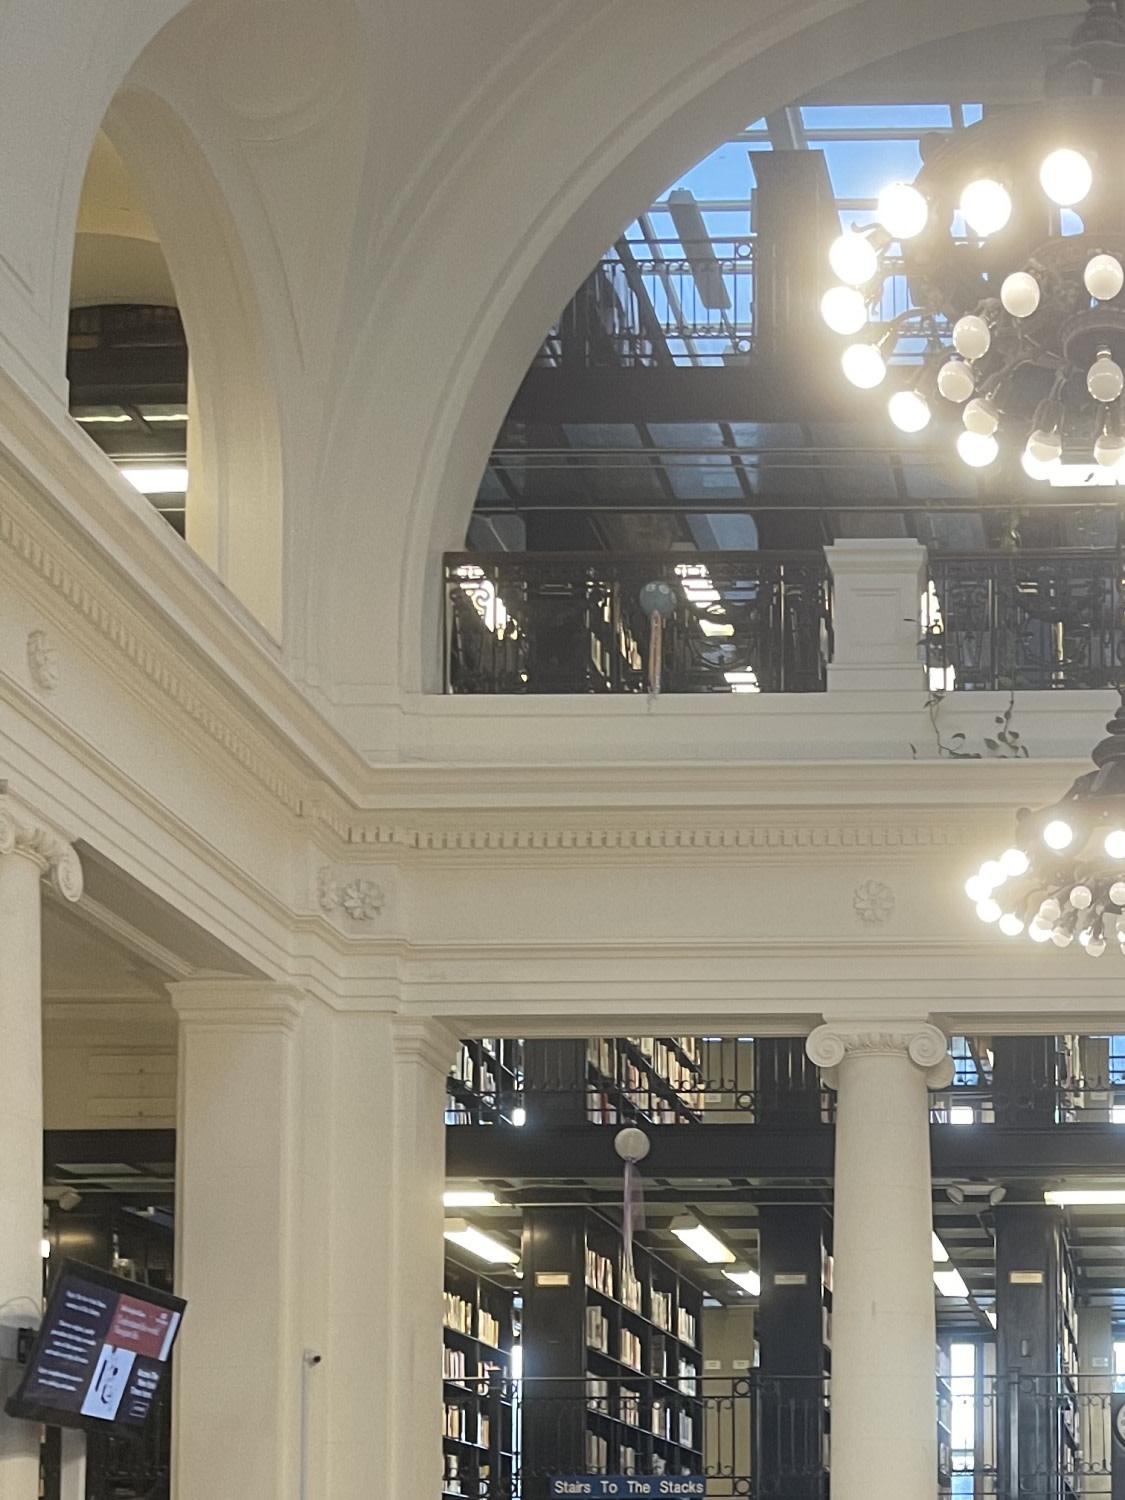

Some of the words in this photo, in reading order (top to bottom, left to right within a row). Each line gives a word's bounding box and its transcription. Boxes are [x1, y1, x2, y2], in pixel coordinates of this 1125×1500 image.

[554, 1480, 591, 1494] Stairs
[600, 1480, 618, 1494] To
[626, 1480, 651, 1494] The
[659, 1480, 704, 1494] Stacks
